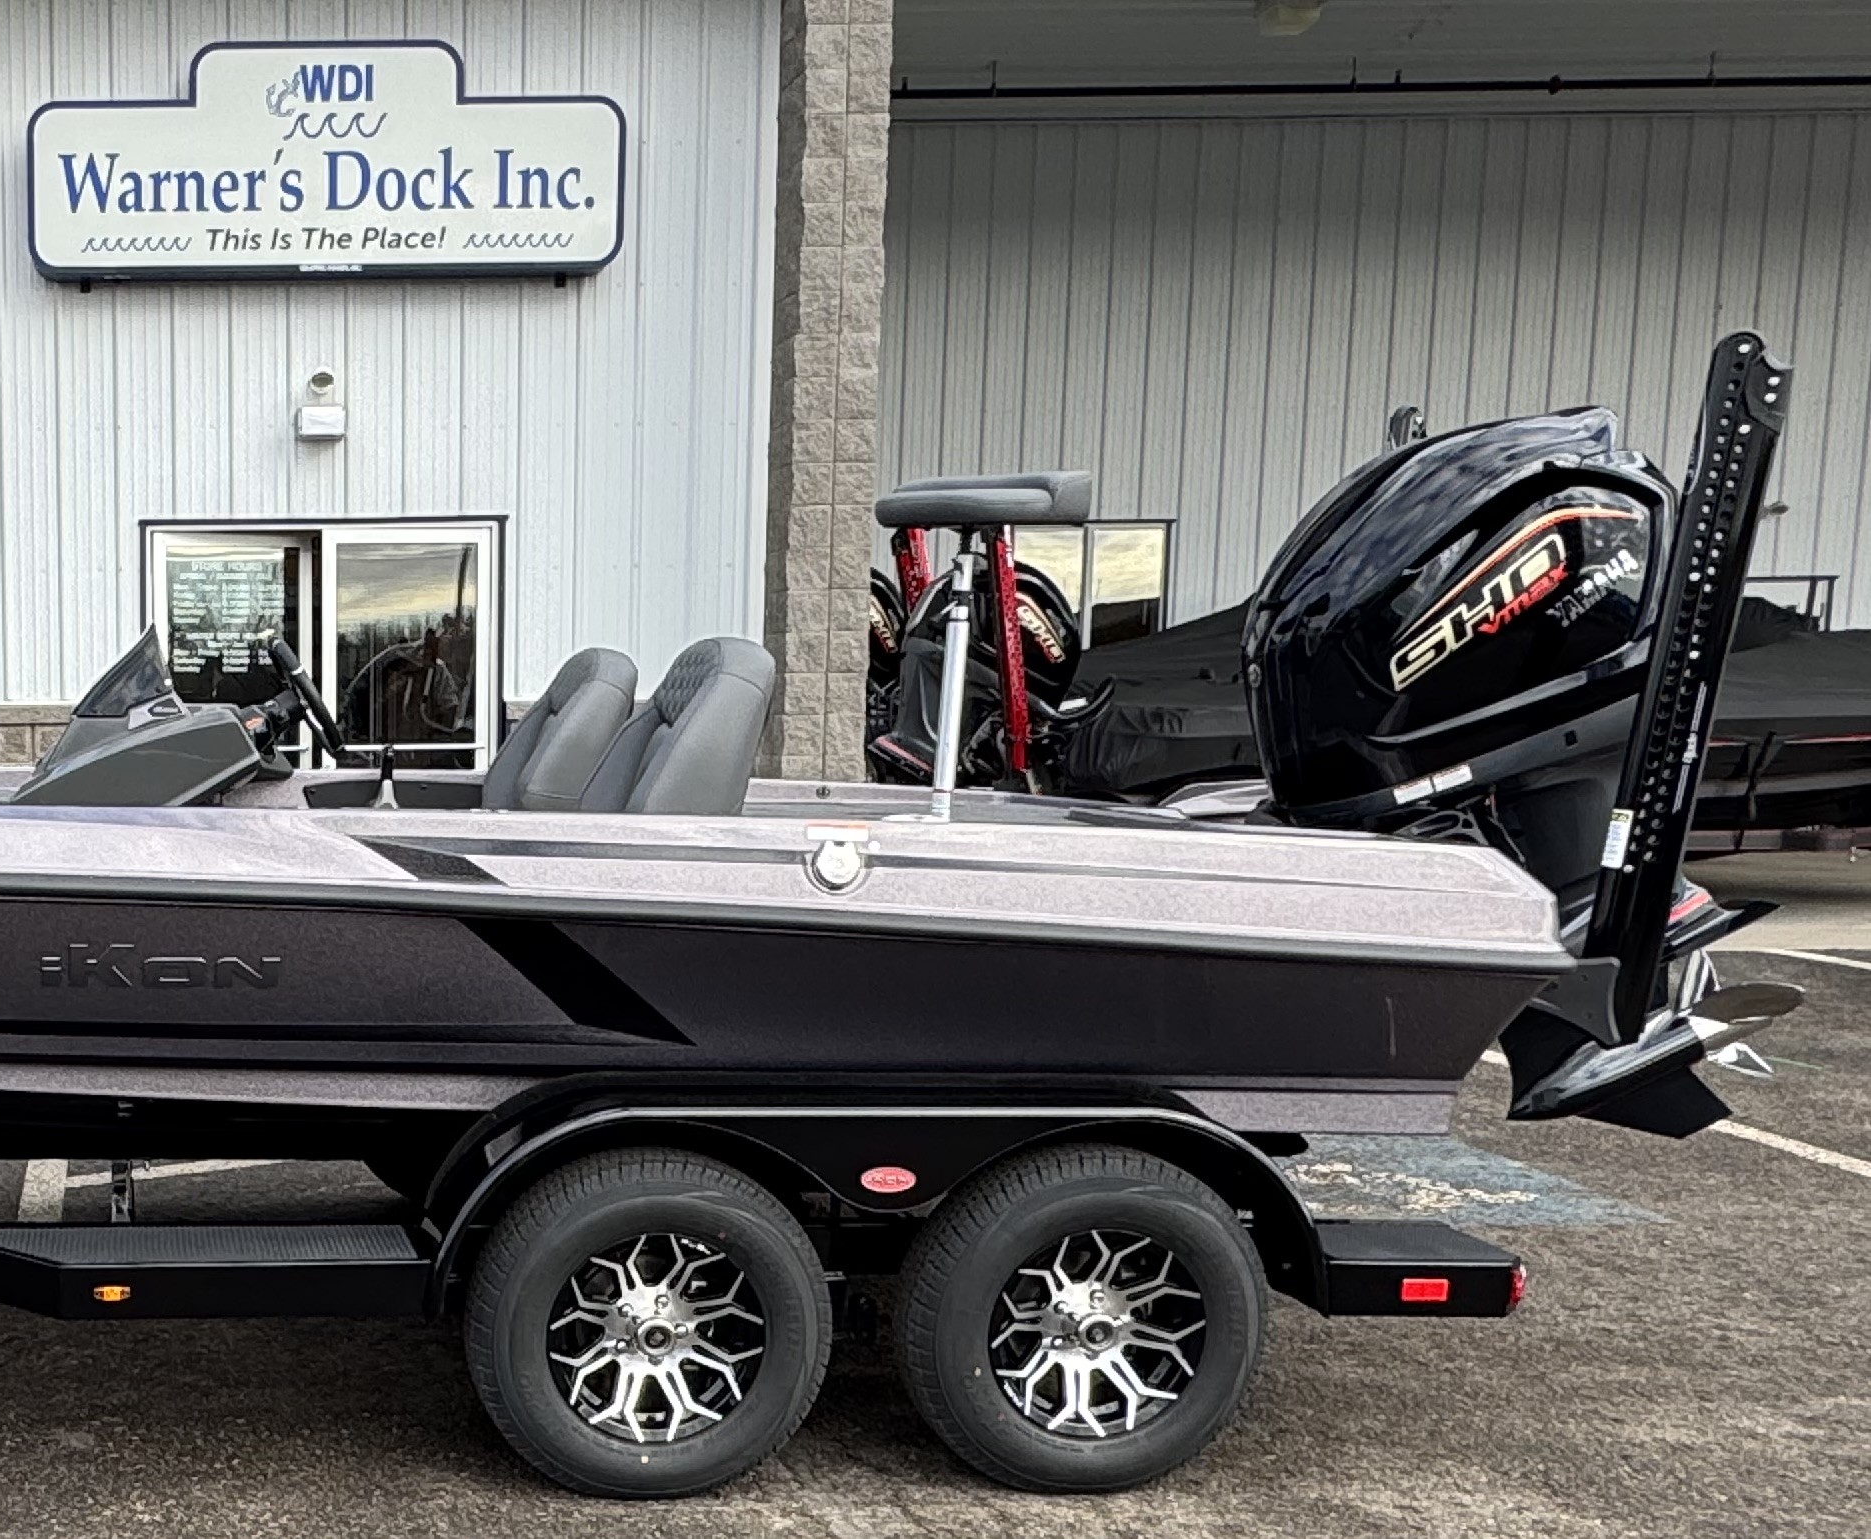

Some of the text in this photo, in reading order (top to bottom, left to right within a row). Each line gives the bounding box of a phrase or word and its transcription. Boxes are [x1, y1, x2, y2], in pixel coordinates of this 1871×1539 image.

[300, 64, 374, 103] WDI
[58, 146, 596, 214] Warner's Dock Inc.
[205, 226, 447, 252] This Is The Place!
[1390, 534, 1567, 692] SHO
[1545, 549, 1639, 628] YAMAHA
